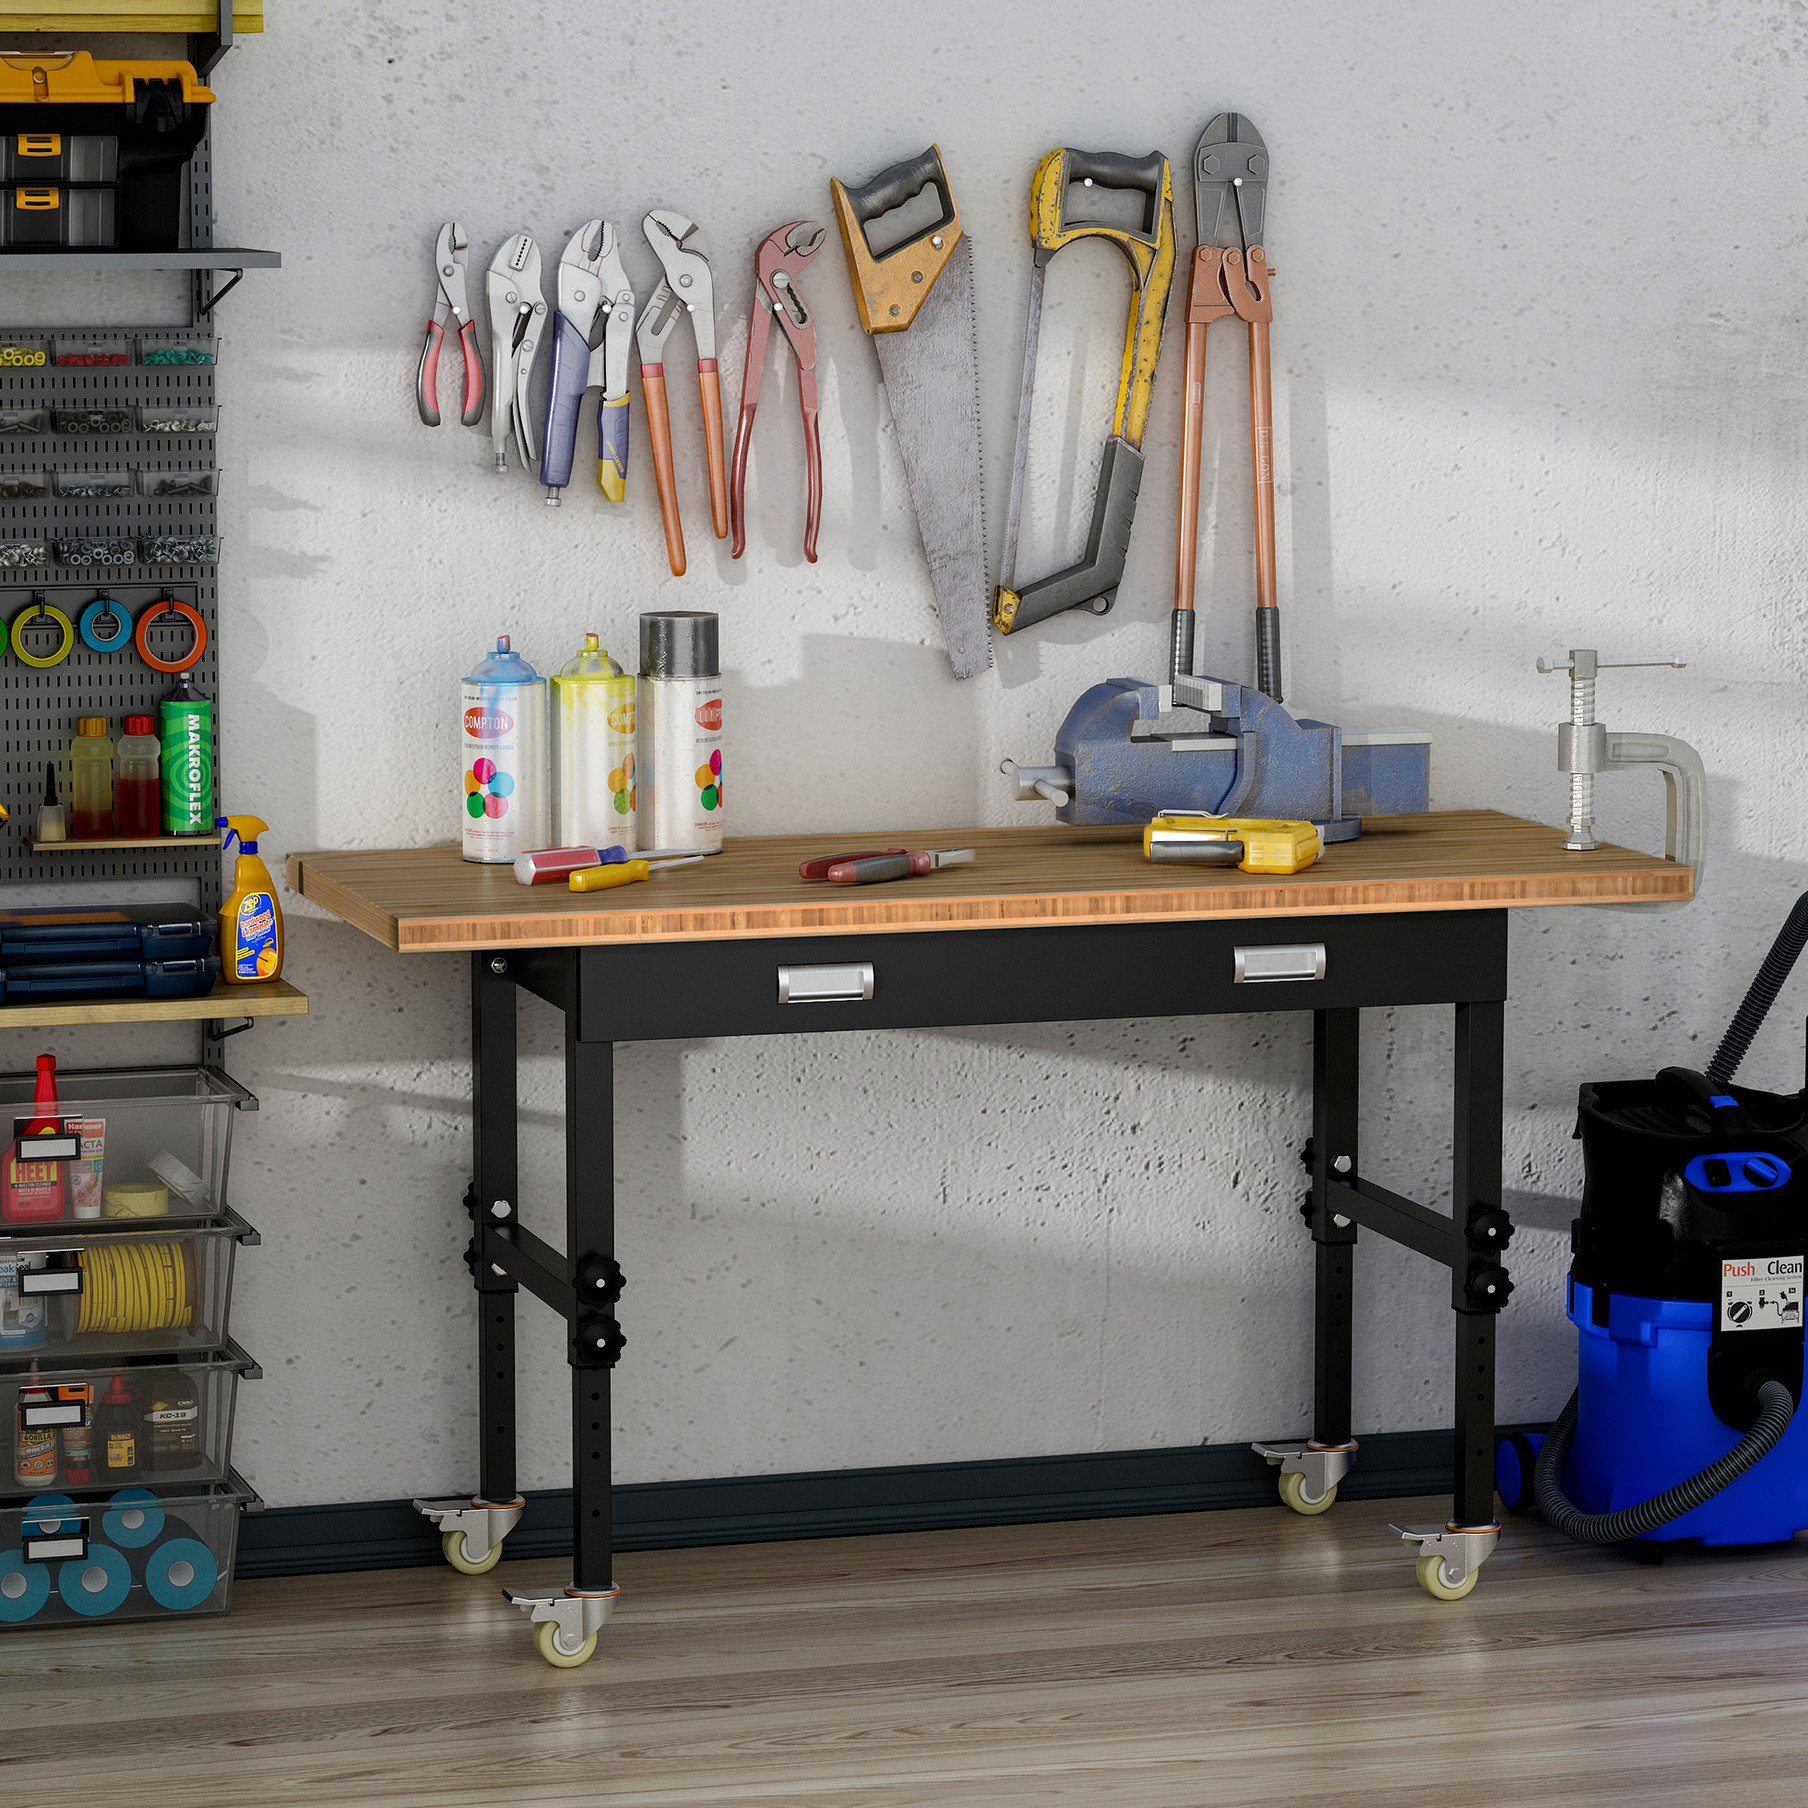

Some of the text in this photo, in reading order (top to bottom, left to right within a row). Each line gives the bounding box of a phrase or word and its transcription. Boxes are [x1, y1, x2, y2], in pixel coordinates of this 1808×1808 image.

[464, 715, 509, 730] COMPTON
[188, 713, 203, 826] MAKROFLEX
[240, 908, 271, 930] hardwood
[246, 917, 273, 935] laminate
[68, 1122, 103, 1130] Hammer
[15, 1161, 56, 1183] HEET
[1724, 1259, 1803, 1278] Push Clean
[24, 1433, 53, 1441] GORILLA
